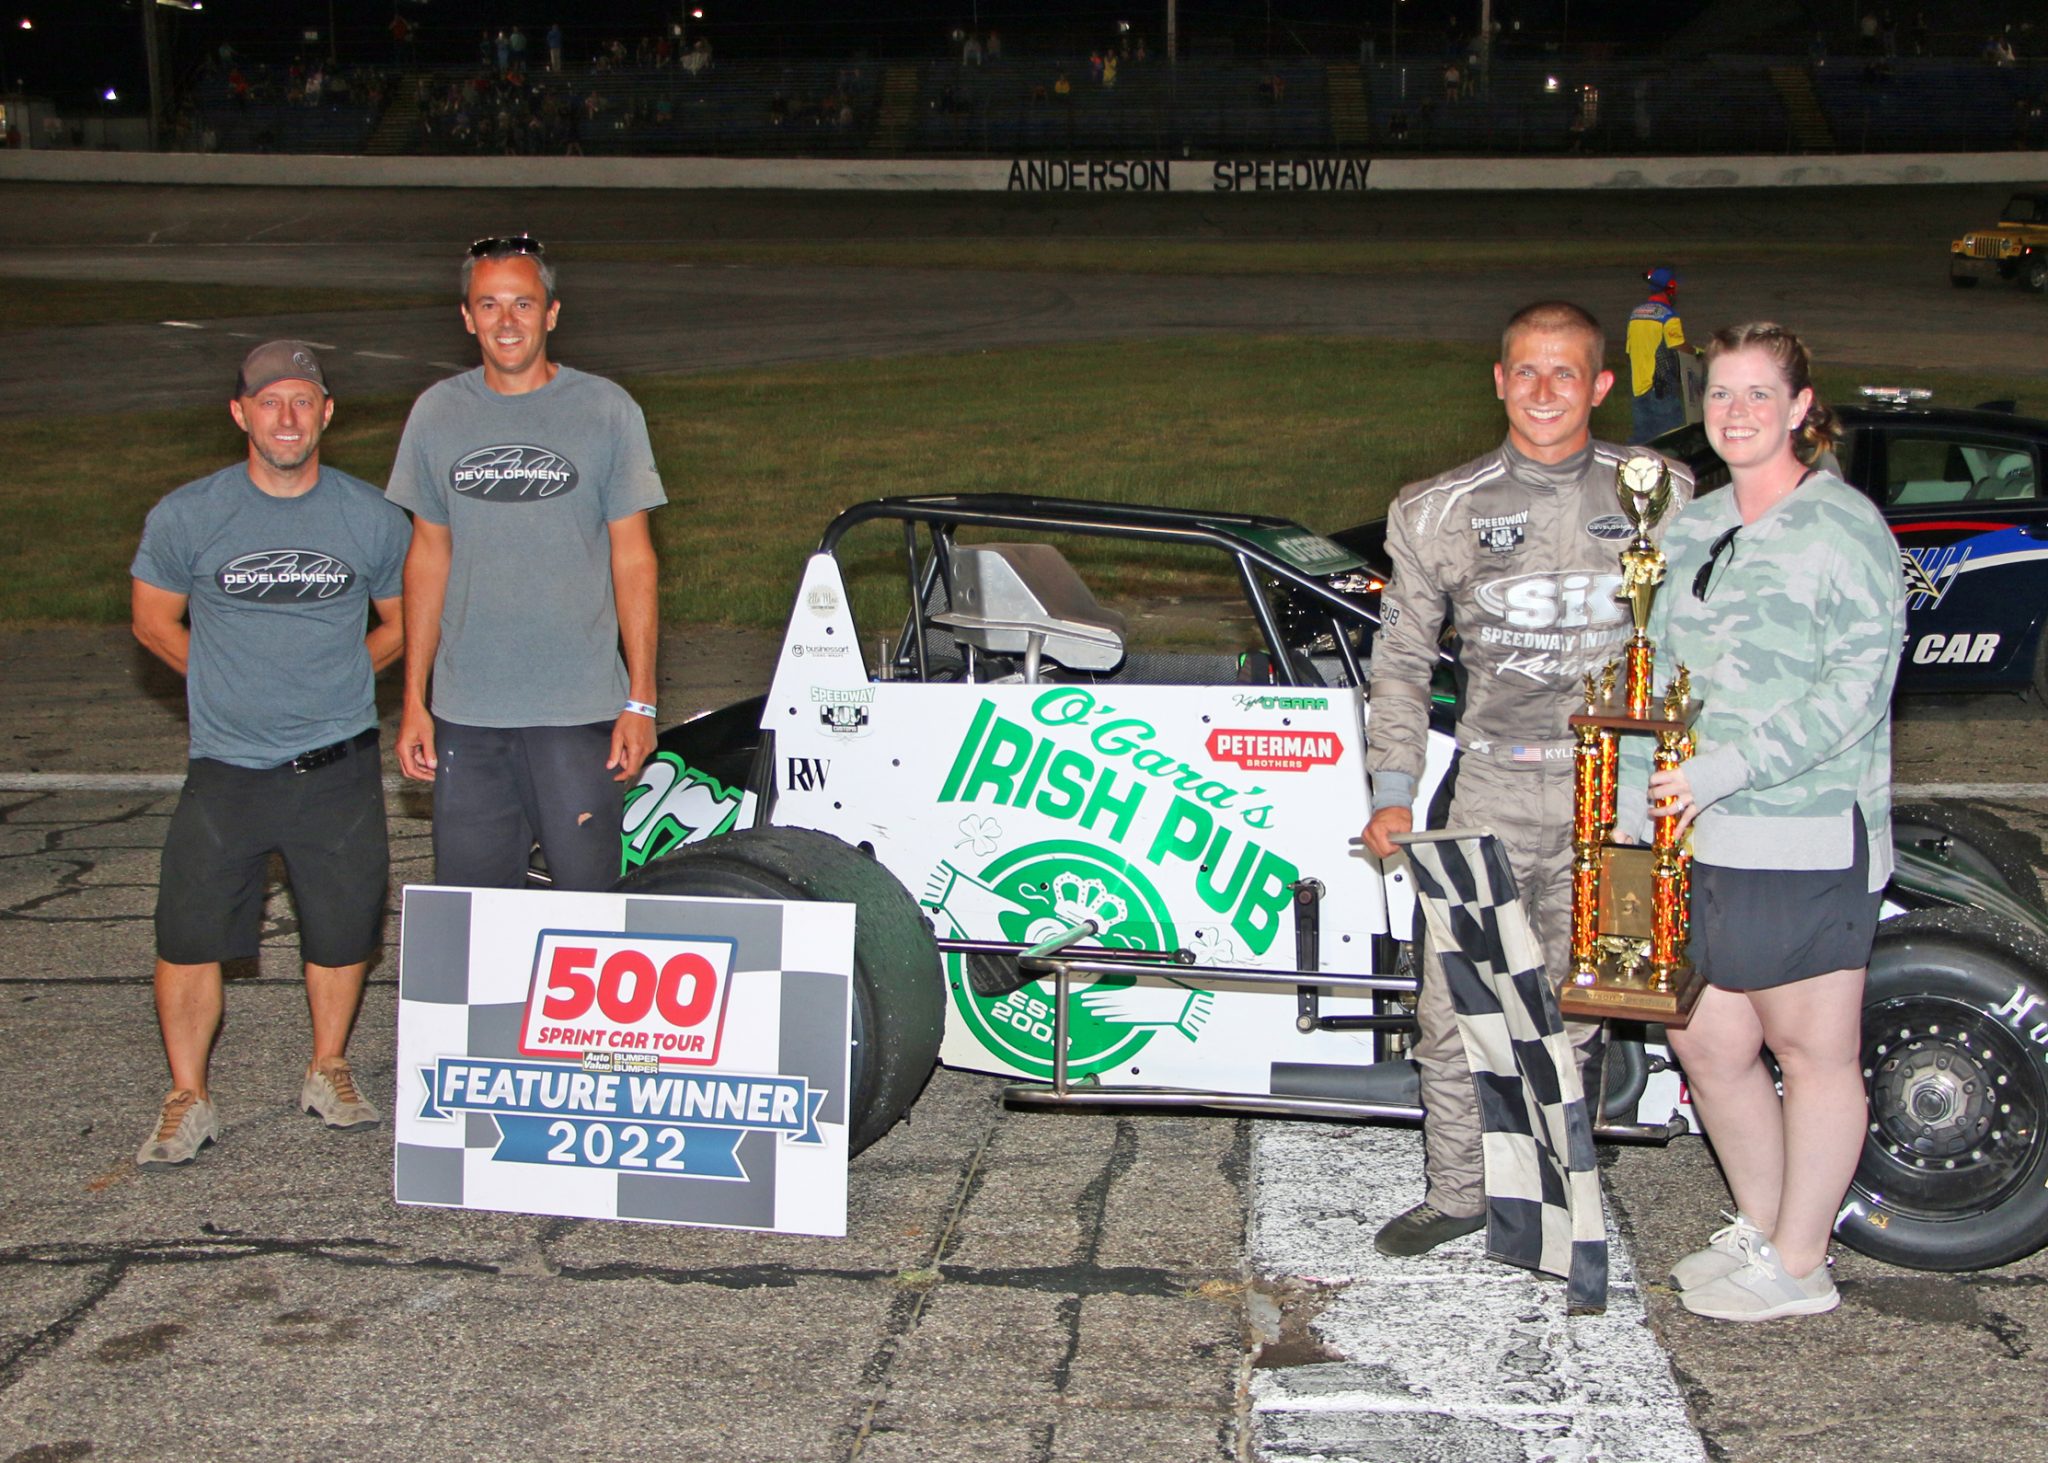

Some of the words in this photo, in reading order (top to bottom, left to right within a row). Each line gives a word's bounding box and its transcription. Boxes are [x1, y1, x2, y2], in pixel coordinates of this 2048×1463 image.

[1008, 160, 1171, 191] ANDERSON
[1213, 160, 1372, 191] SPEEDWAY
[455, 469, 571, 482] DEVELOPMENT
[1471, 510, 1529, 530] SPEEDWAY
[224, 573, 349, 584] DEVELOPMENT
[1480, 626, 1577, 652] SPEEDWAY
[1912, 634, 2000, 664] CAR
[811, 686, 876, 703] SPEEDWAY
[1262, 695, 1329, 710] O'GARA
[1031, 687, 1275, 829] O'Gara's
[1217, 734, 1333, 758] PETERMAN
[786, 757, 831, 791] RW
[1246, 759, 1303, 769] BROTHERS
[937, 698, 1148, 843] IRISH
[1146, 795, 1300, 956] PUB
[542, 946, 718, 1028] 500
[537, 1027, 607, 1049] SPRINT
[608, 1030, 652, 1051] CAR
[652, 1033, 705, 1053] TOUR
[583, 1061, 610, 1070] Value
[585, 1052, 609, 1062] Auto
[613, 1053, 659, 1064] BUMPER
[613, 1064, 658, 1075] BUMPER
[442, 1065, 618, 1112] FEATURE
[628, 1076, 799, 1124] WINNER
[547, 1121, 686, 1170] 2022
